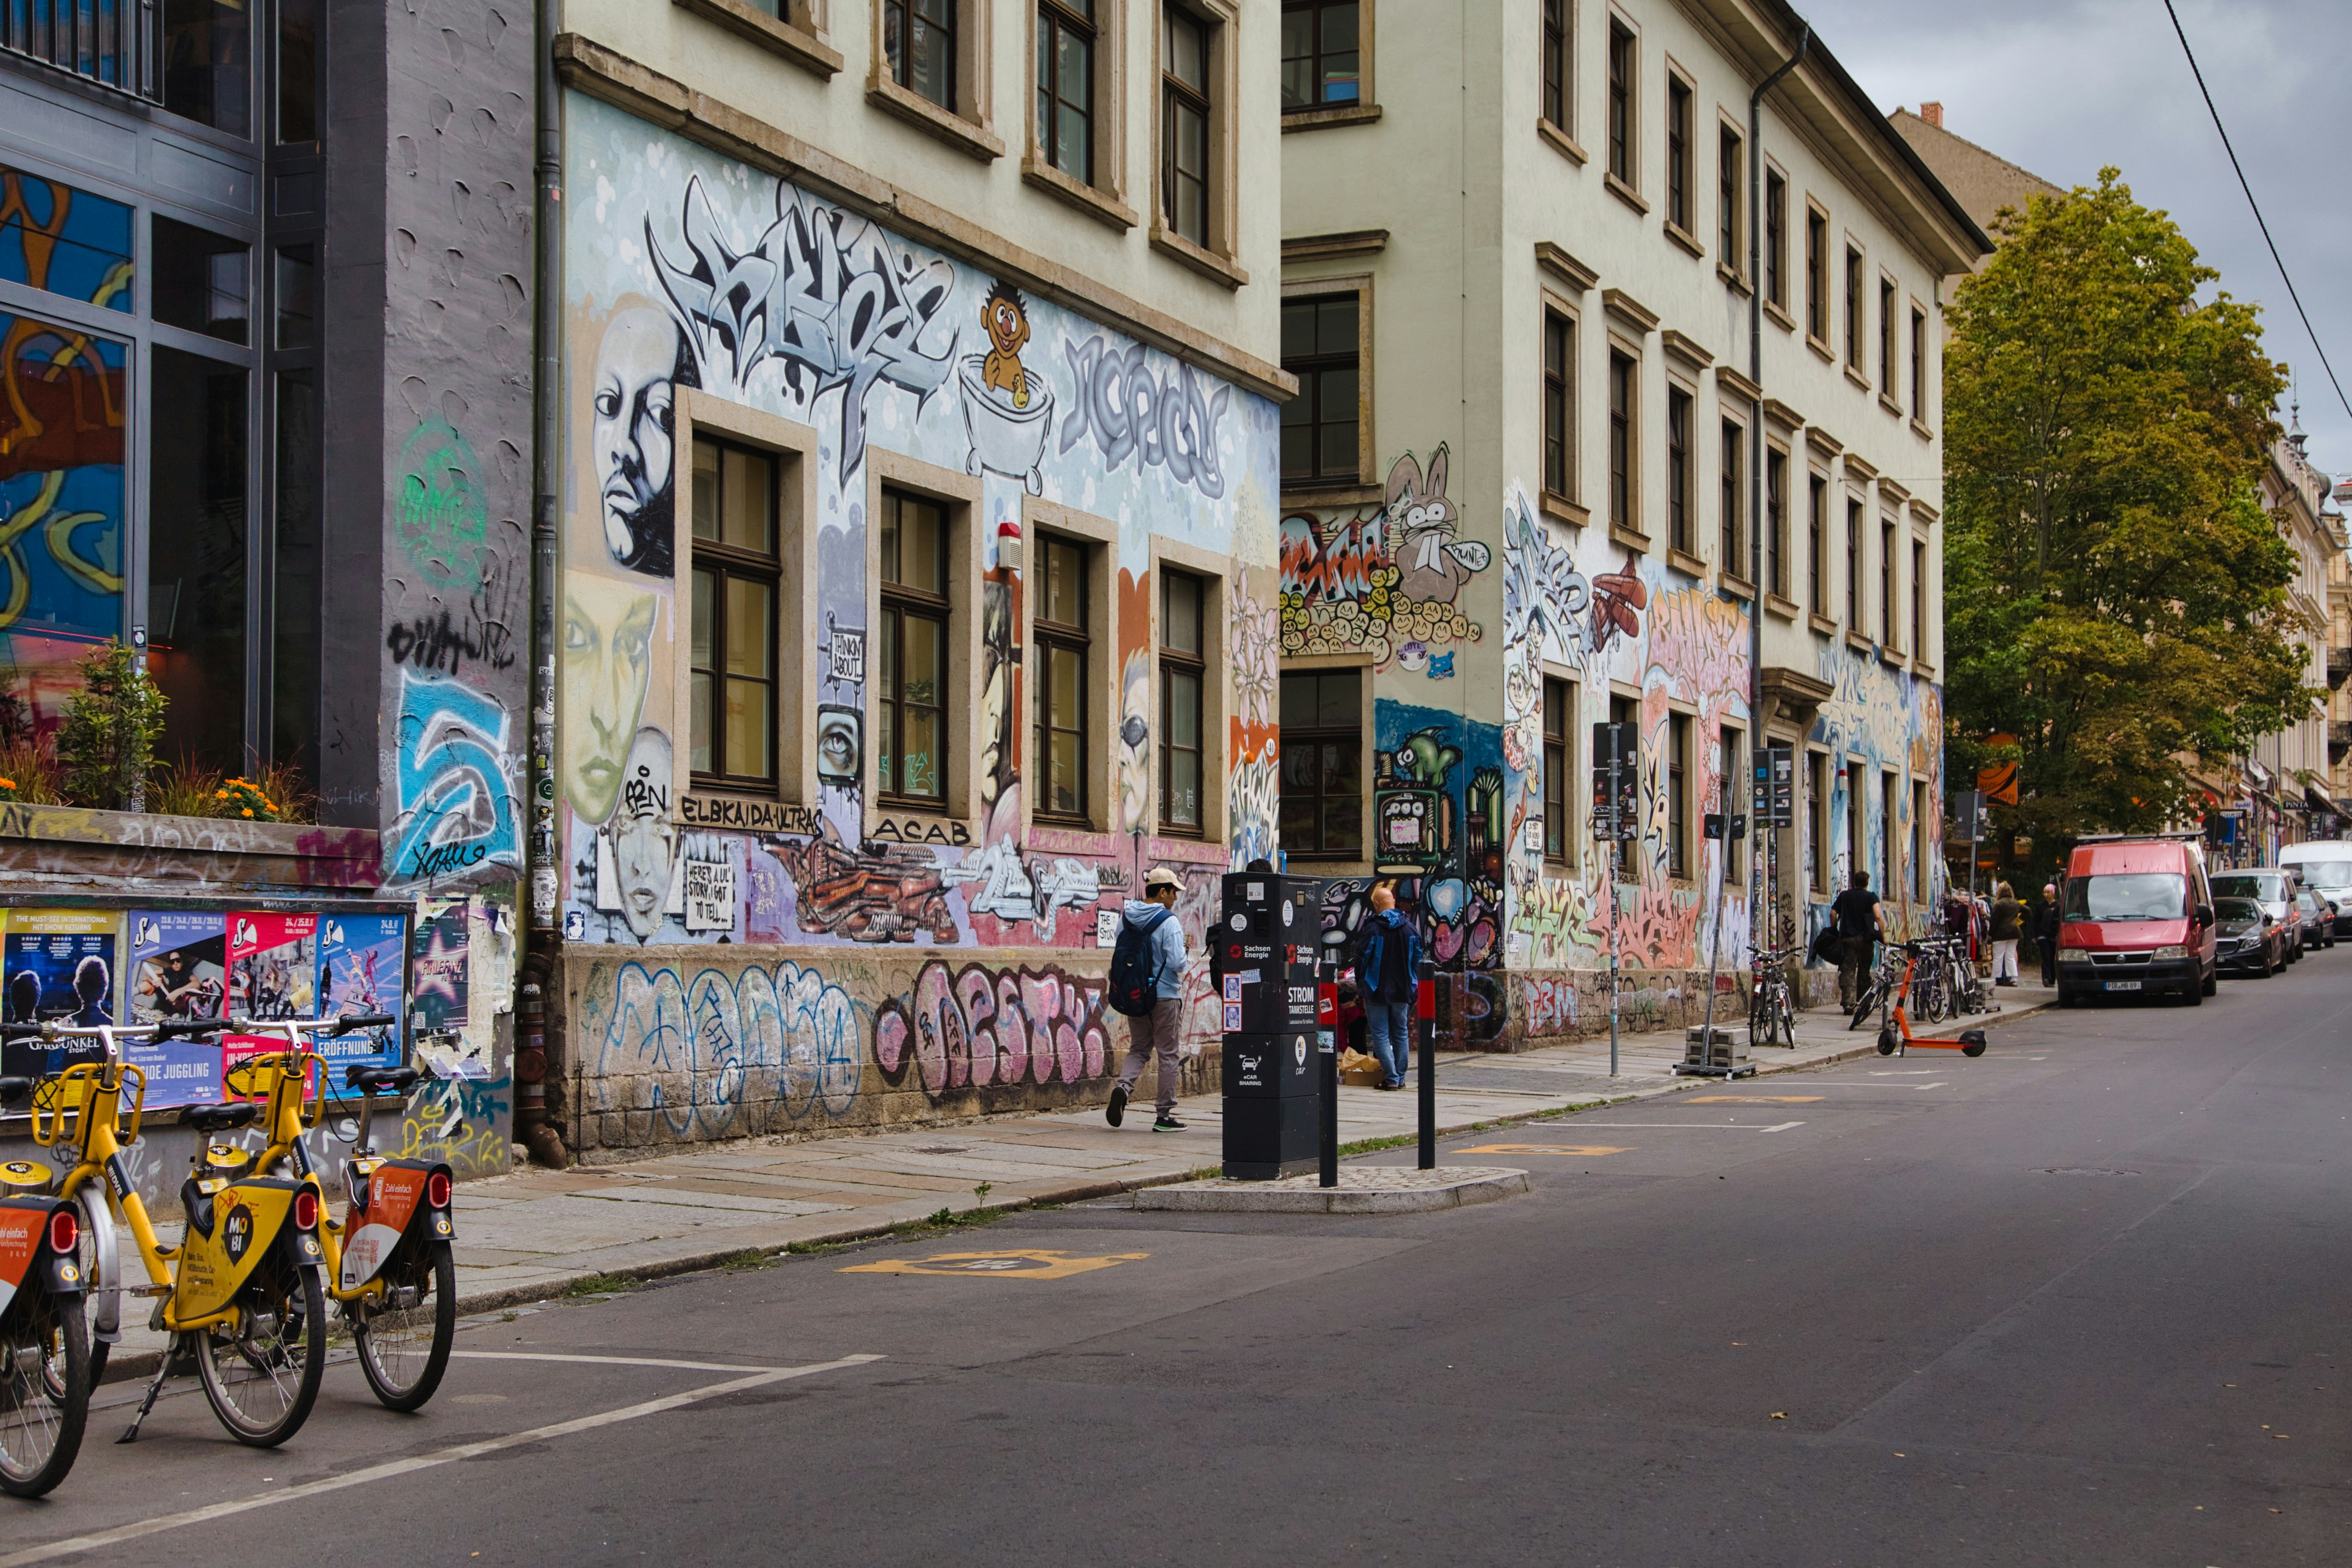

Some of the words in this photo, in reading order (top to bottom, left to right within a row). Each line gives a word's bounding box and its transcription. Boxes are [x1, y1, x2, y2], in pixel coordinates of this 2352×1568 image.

[1404, 642, 1421, 651] LOVE
[873, 819, 971, 845] ACAB
[690, 865, 712, 883] HERE'S
[714, 868, 719, 883] A
[714, 885, 727, 902] GOT
[696, 901, 703, 919] TO
[382, 920, 393, 929] 24.8.
[1100, 914, 1110, 925] THE
[1100, 927, 1116, 941] STORY
[1297, 945, 1313, 954] Sachsen
[1296, 954, 1312, 965] Energie
[1288, 987, 1314, 1003] STROM
[1289, 1005, 1314, 1014] TANKSTELLE
[319, 1039, 373, 1056] ERÖFFNUNG
[163, 1063, 209, 1079] JUGGLING
[1296, 1066, 1306, 1076] car
[294, 1155, 303, 1176] DVB
[111, 1174, 123, 1197] DVB
[385, 1184, 395, 1192] Zahl
[395, 1184, 412, 1194] einfach
[389, 1194, 411, 1202] Handyrechnung
[229, 1217, 248, 1234] MO
[6, 1228, 28, 1239] einfach
[231, 1235, 242, 1251] BI
